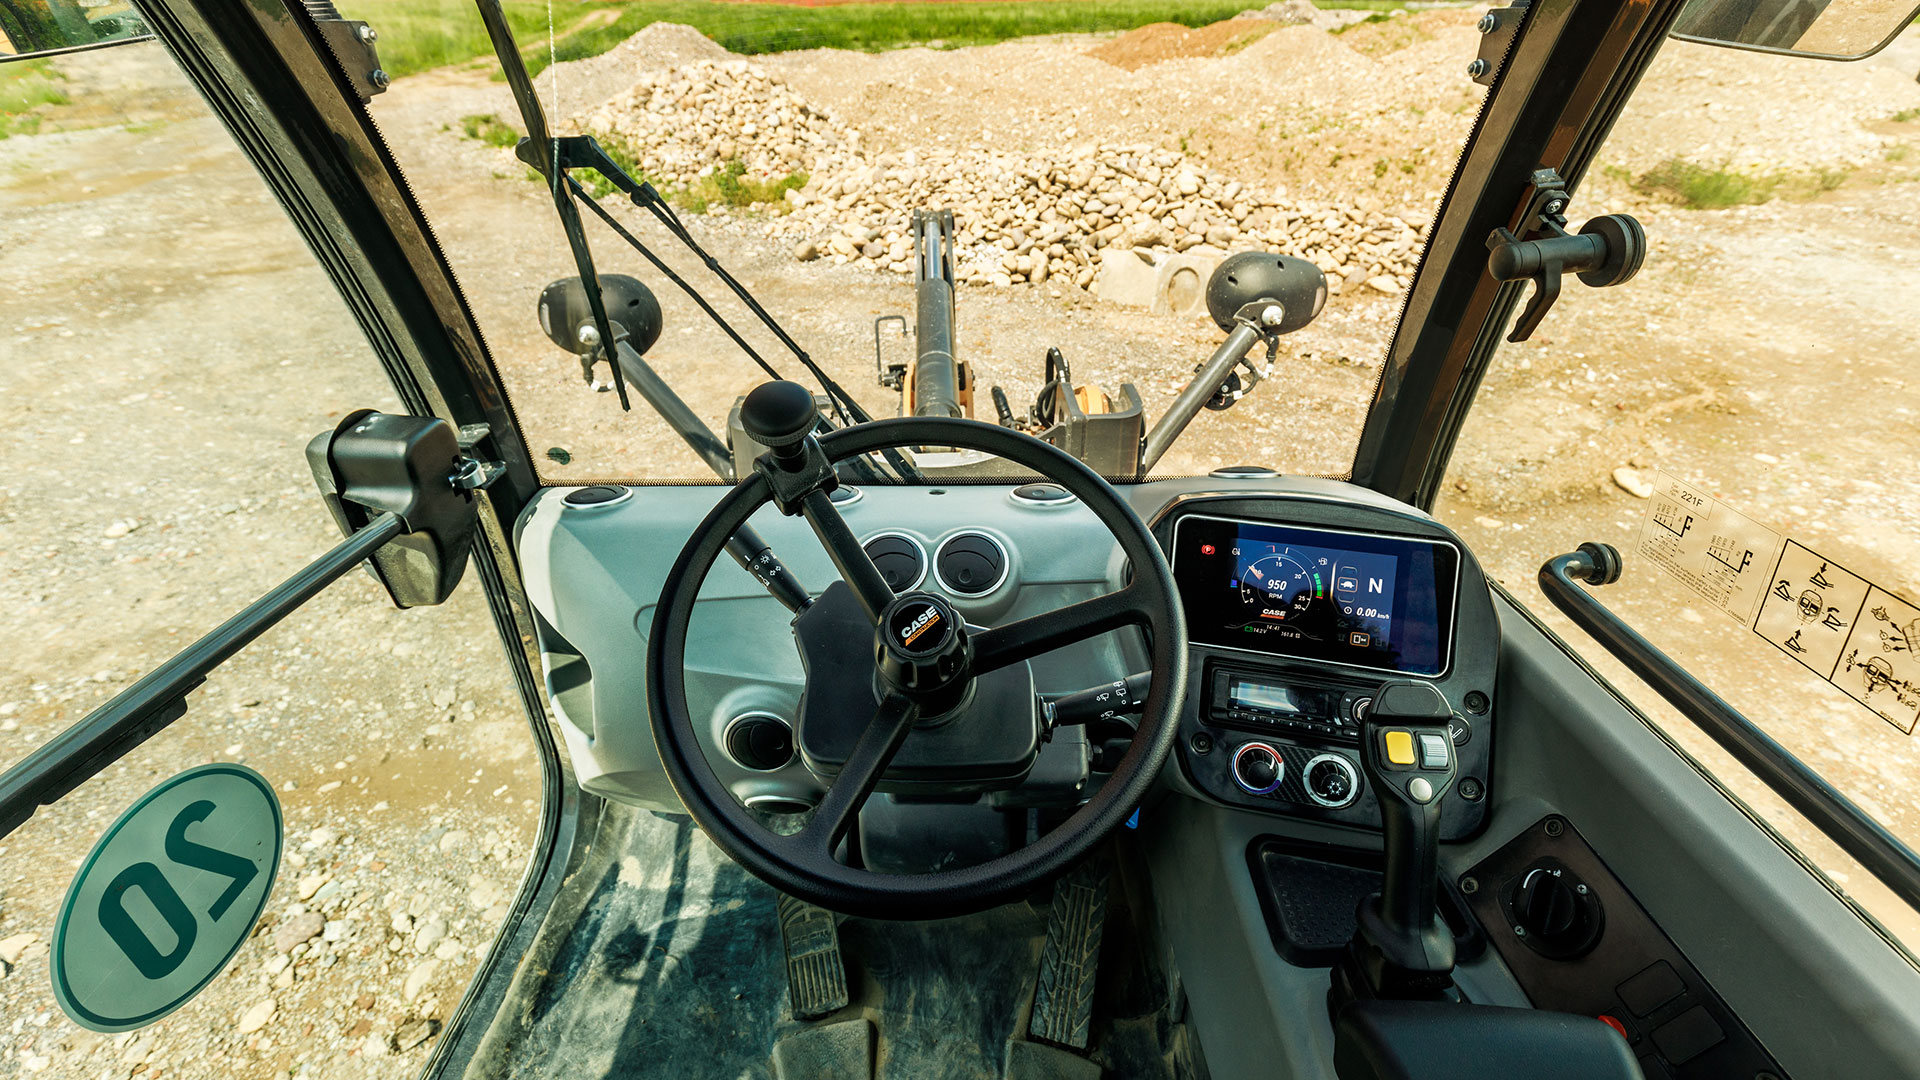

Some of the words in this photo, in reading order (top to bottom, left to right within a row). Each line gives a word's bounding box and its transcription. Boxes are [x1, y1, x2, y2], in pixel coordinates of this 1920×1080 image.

[1680, 490, 1704, 507] 221F
[1267, 579, 1287, 591] 950
[1368, 577, 1383, 594] N
[1268, 592, 1283, 600] RPM
[1262, 608, 1287, 617] CASE
[1356, 606, 1377, 618] 0.00
[901, 605, 938, 638] CASE
